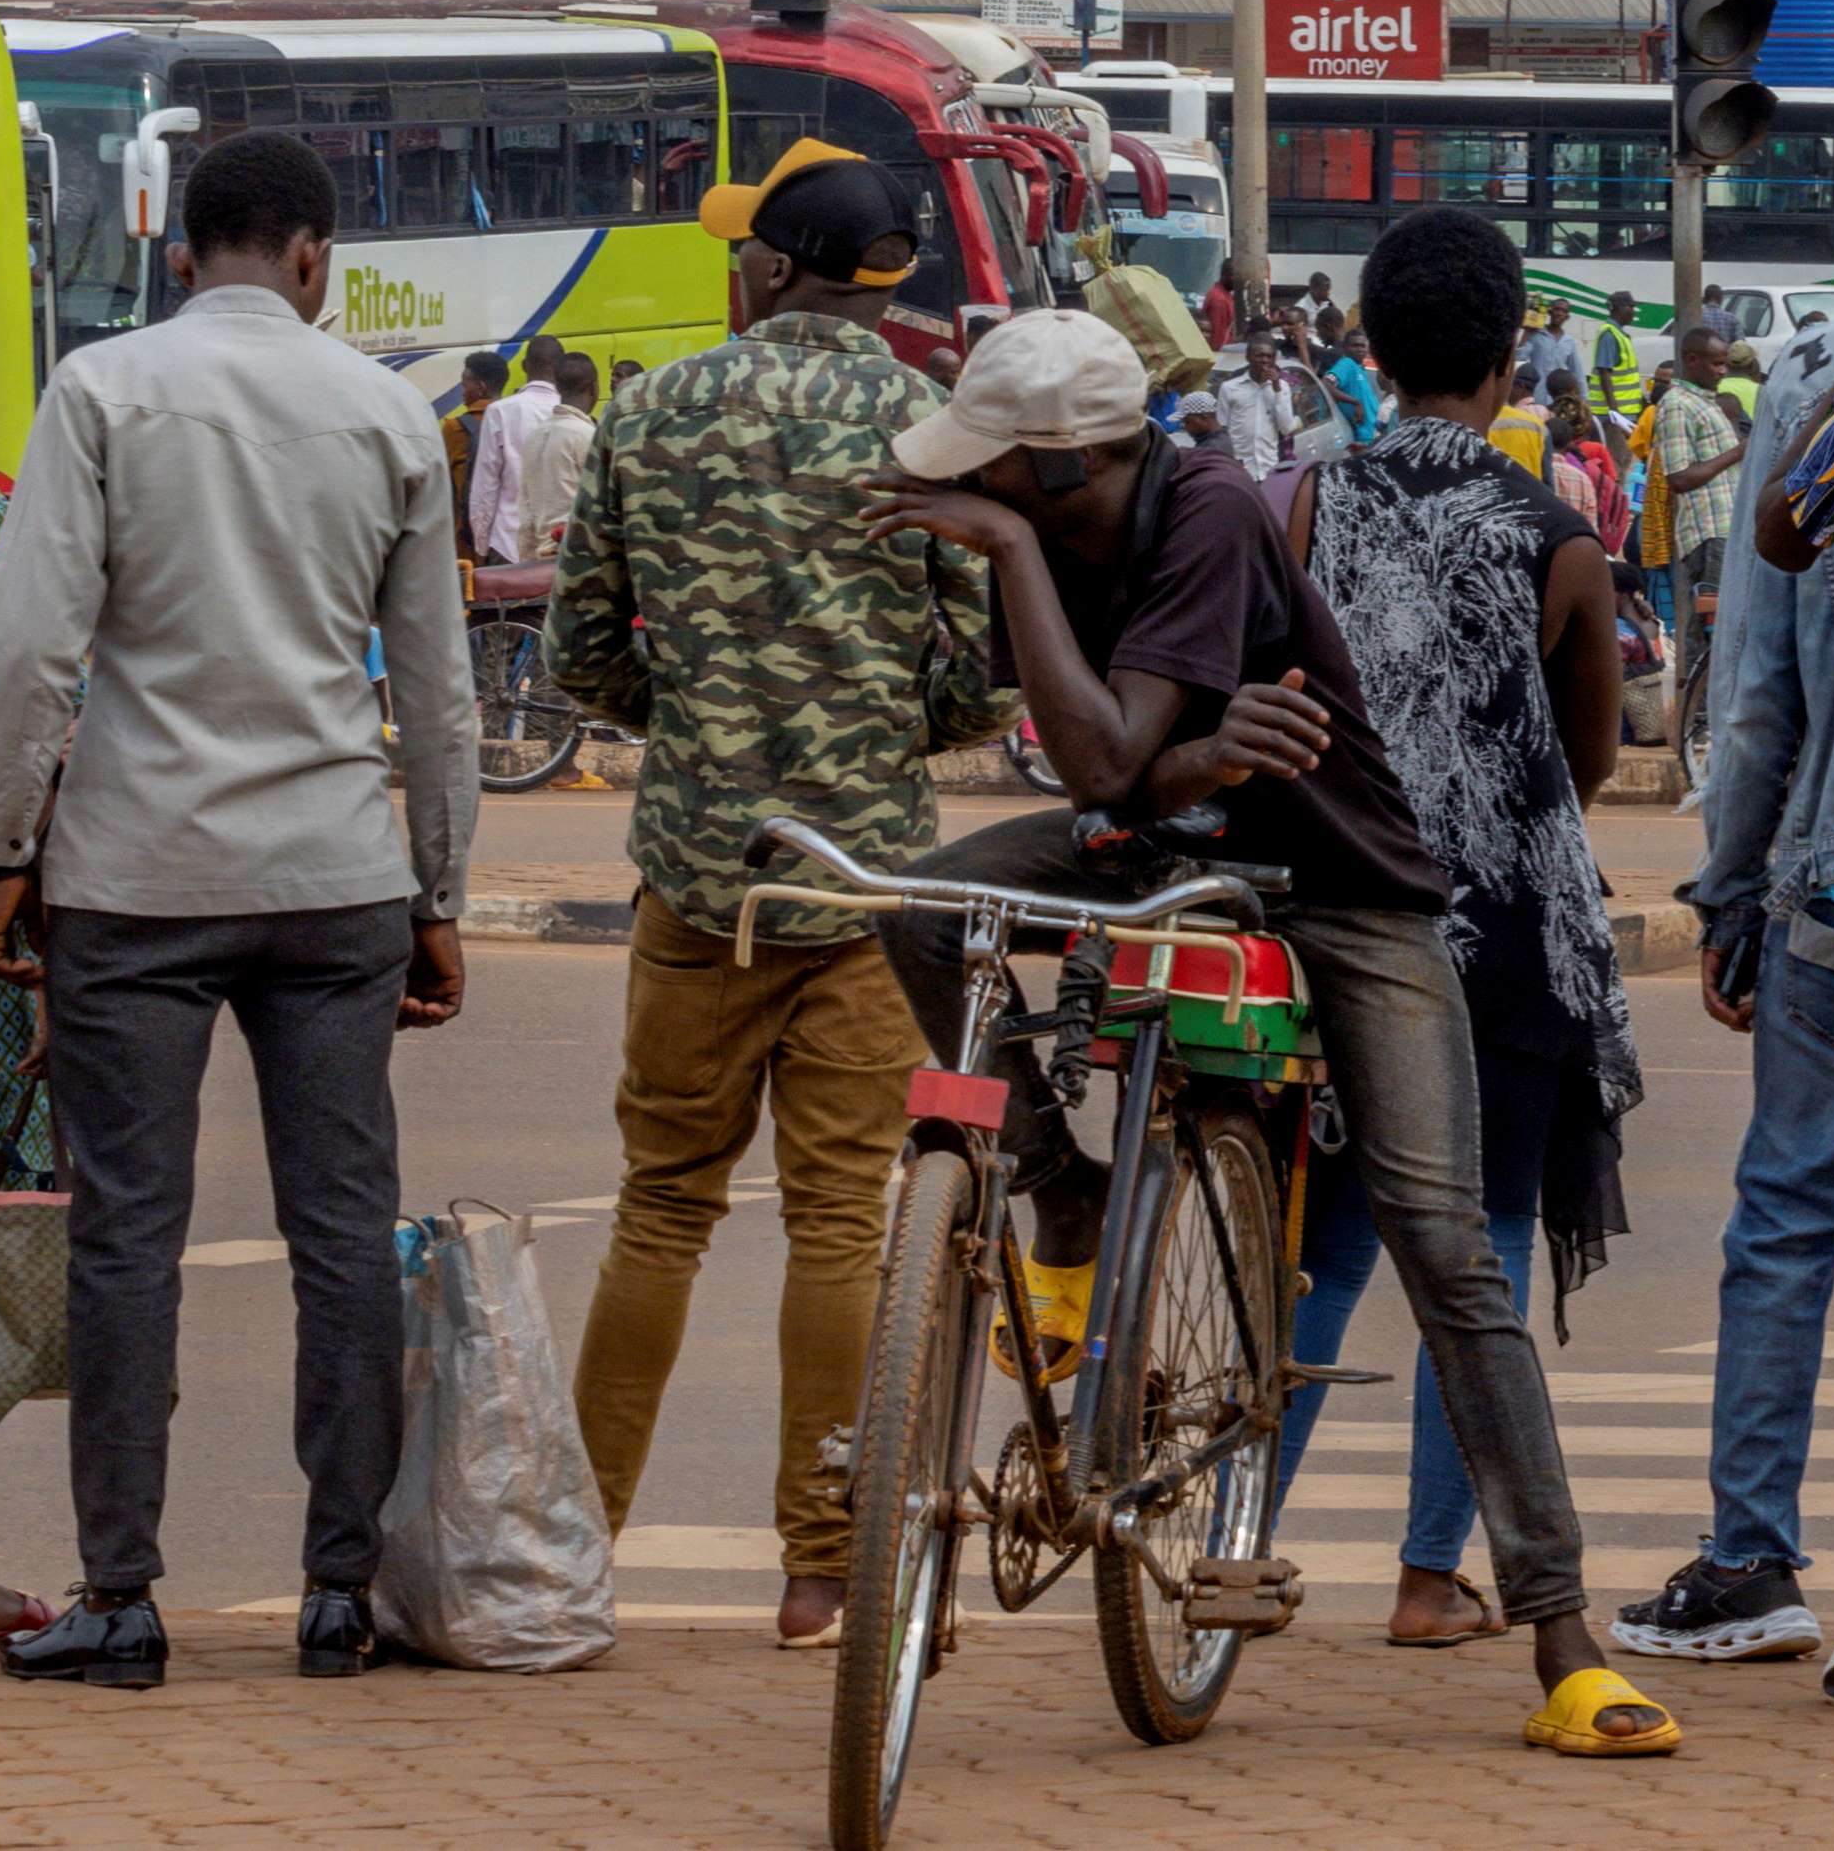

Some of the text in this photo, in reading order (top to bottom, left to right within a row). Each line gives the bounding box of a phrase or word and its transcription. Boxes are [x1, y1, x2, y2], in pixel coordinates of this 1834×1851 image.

[1289, 6, 1418, 53] airtel
[1308, 57, 1389, 80] money
[345, 265, 445, 334] Ritco Ltd
